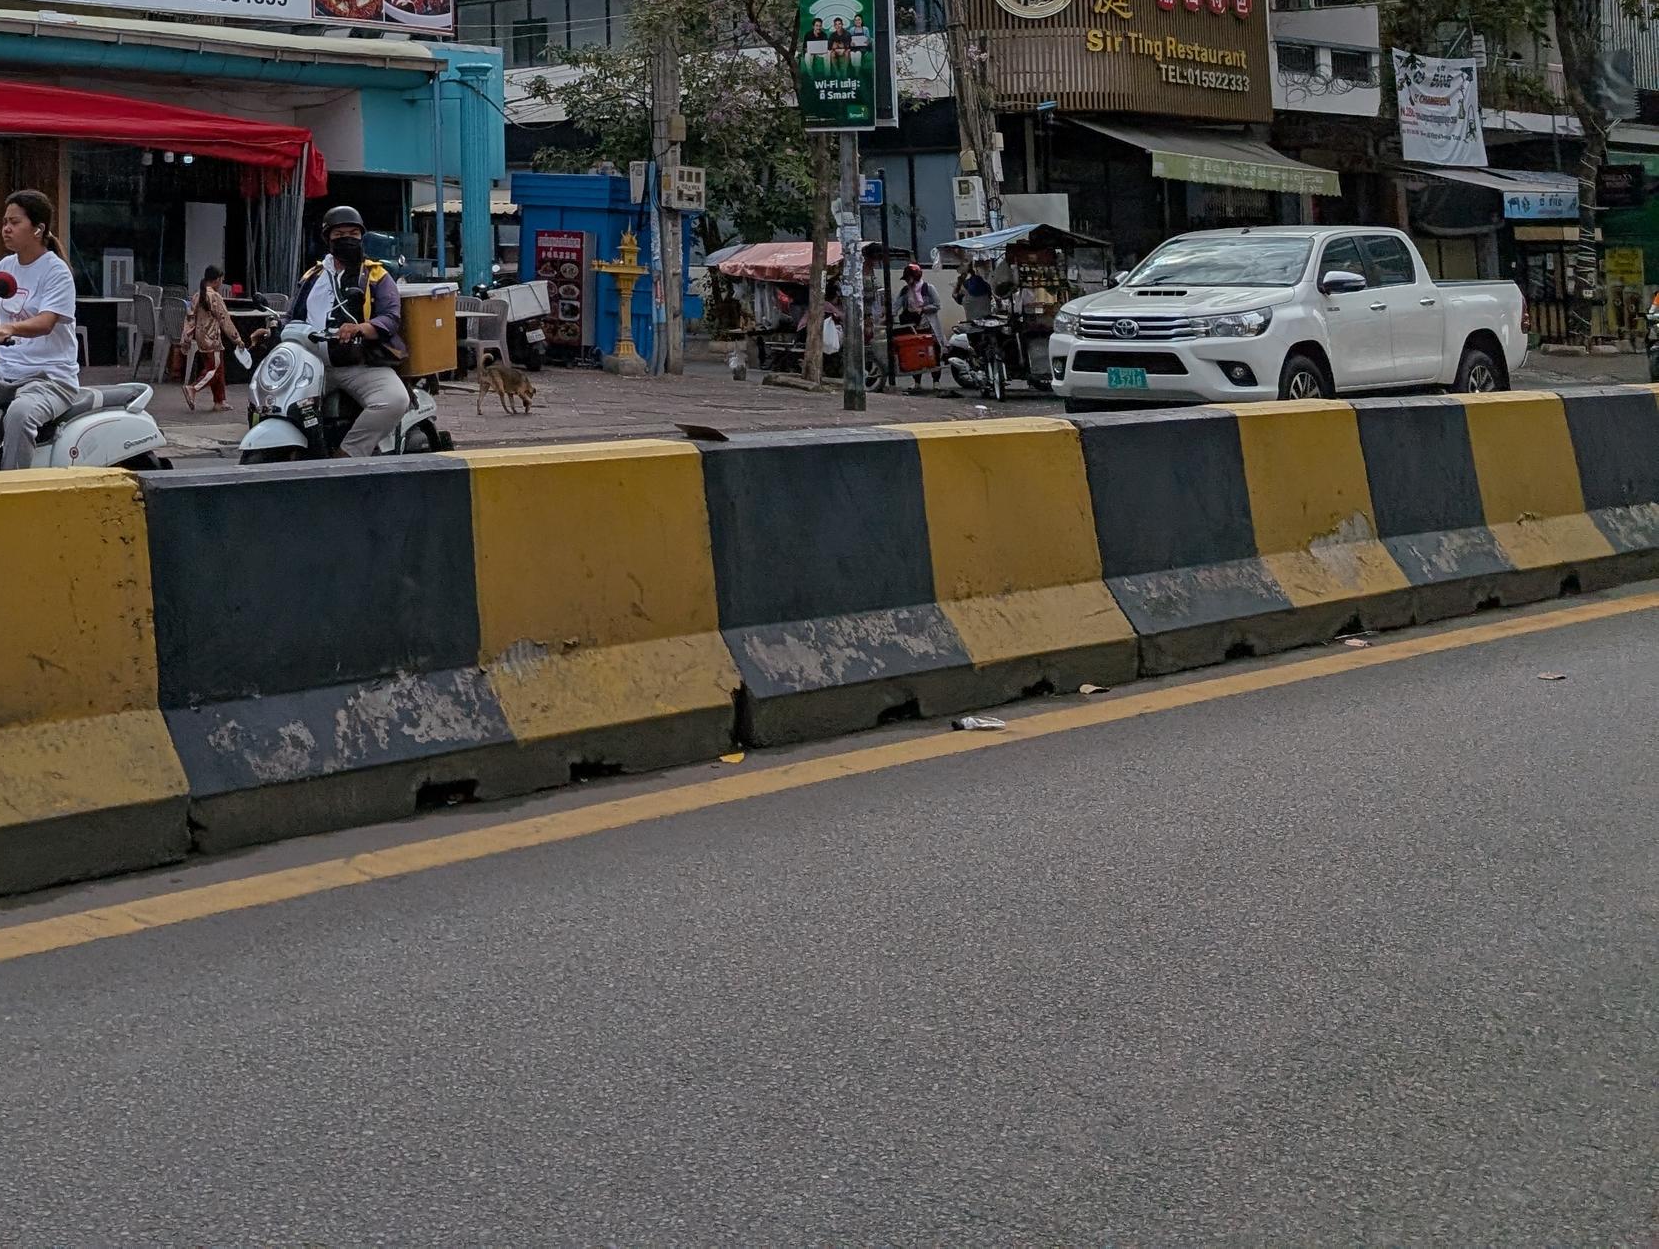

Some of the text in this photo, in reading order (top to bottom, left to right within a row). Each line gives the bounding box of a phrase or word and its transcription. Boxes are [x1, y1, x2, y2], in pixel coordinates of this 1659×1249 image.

[1086, 29, 1248, 69] Sir Ting Restaurant
[814, 78, 839, 90] Wi-Fi
[1159, 63, 1251, 92] TEL:015922333
[827, 90, 857, 100] Smart
